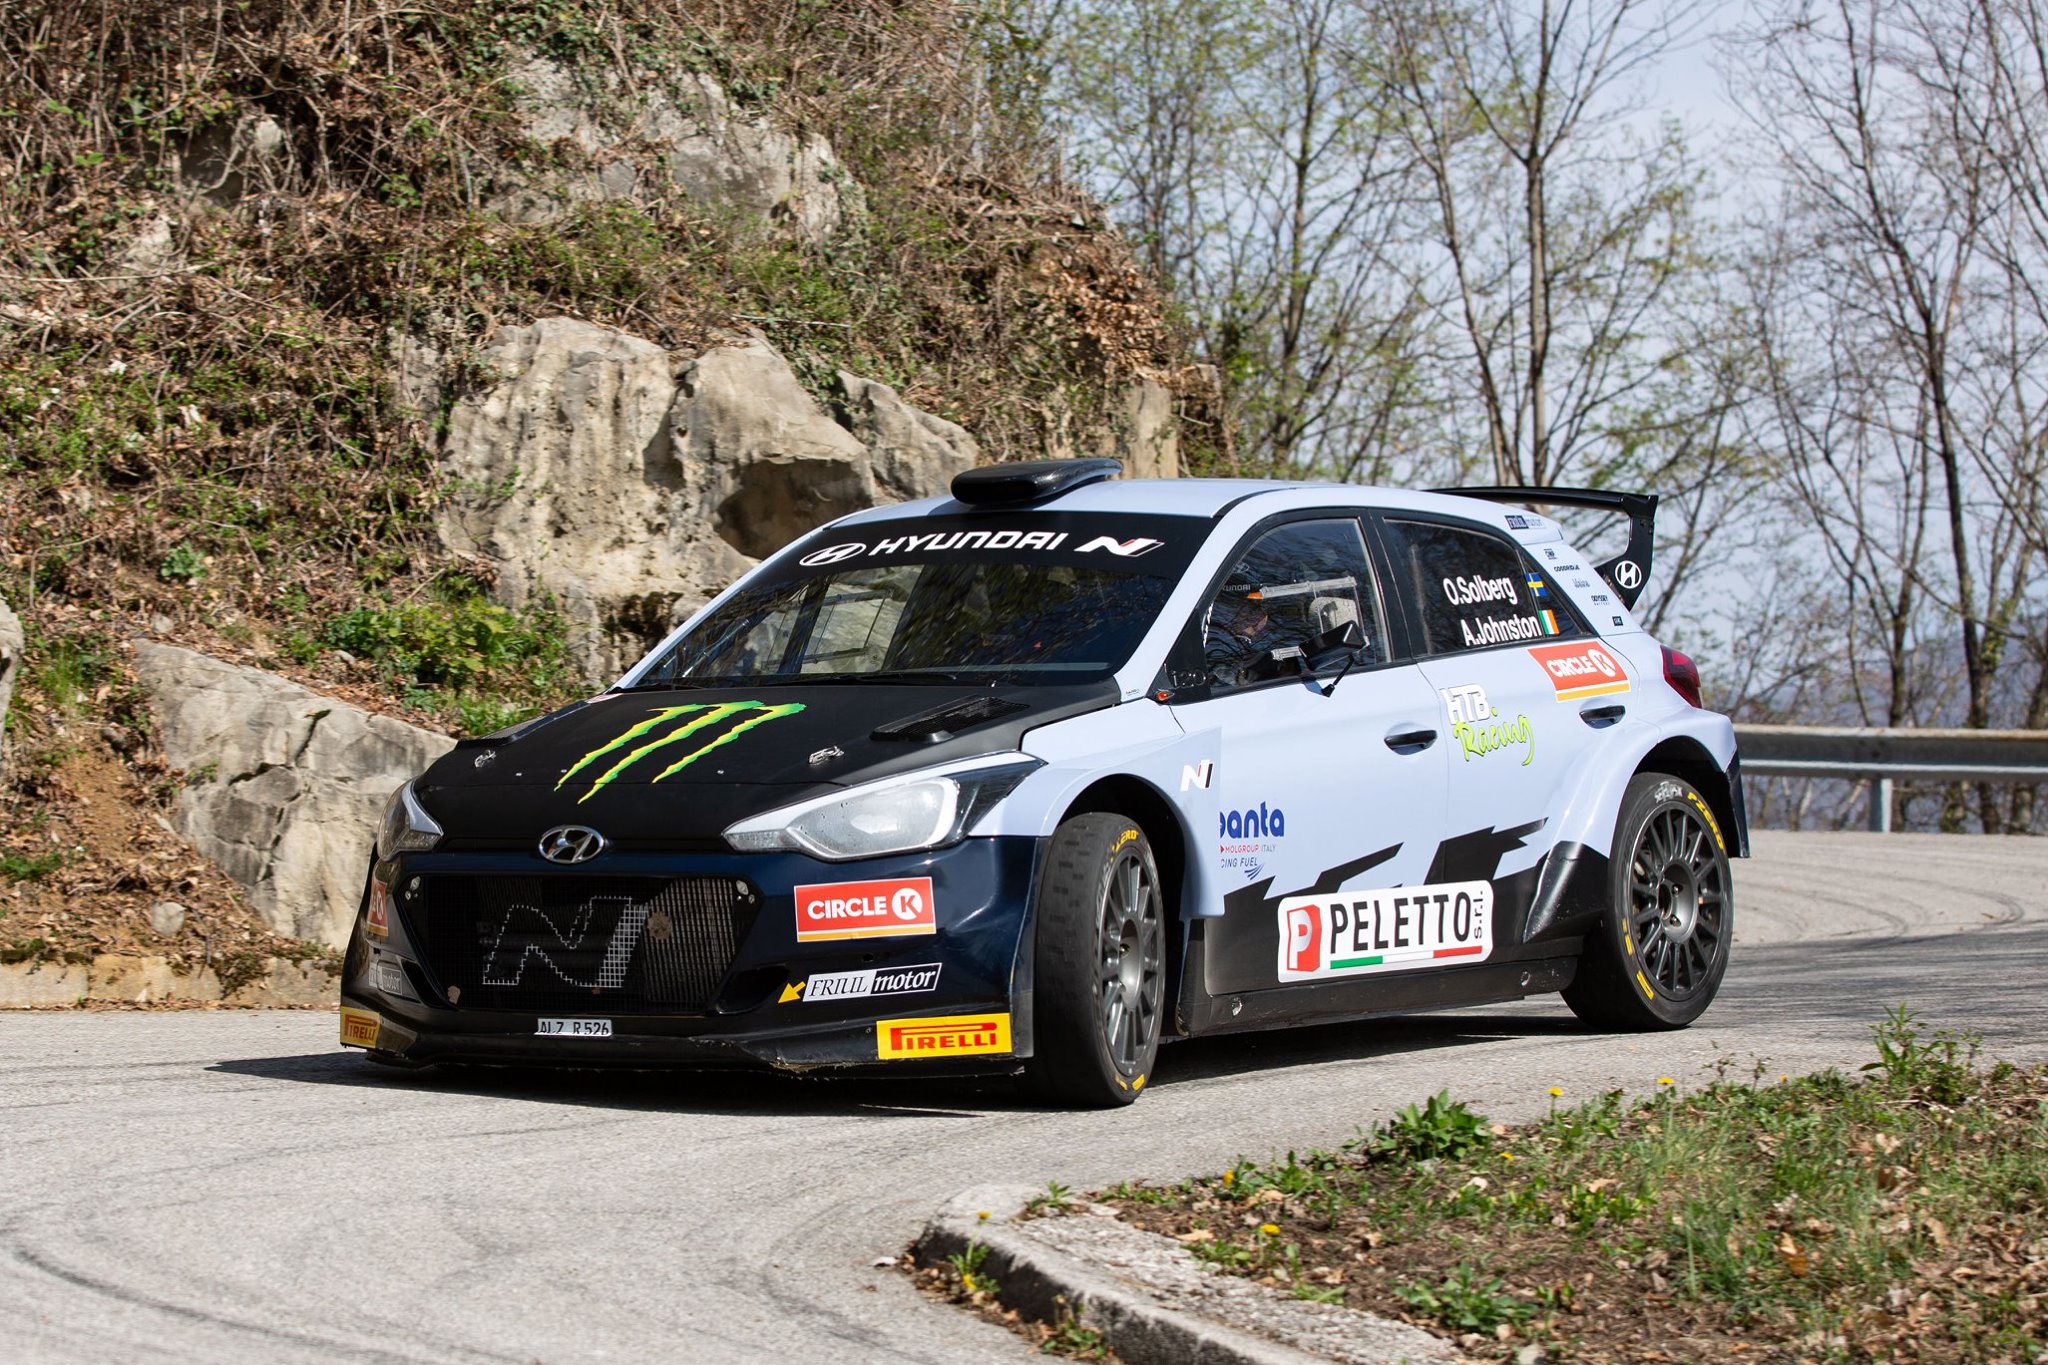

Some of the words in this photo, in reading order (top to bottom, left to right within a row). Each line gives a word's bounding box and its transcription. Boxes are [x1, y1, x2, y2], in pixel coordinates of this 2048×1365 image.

[869, 531, 1068, 555] HYUNDAI
[1443, 575, 1518, 605] O.Solberg
[1461, 614, 1542, 646] A.Johnston
[1546, 656, 1597, 678] CIRCLE
[1439, 683, 1490, 725] HTB
[1453, 707, 1534, 766] Racing
[1225, 844, 1259, 853] MOLGROUP
[1261, 844, 1276, 852] ITALY
[1240, 857, 1258, 867] FUEL
[807, 896, 887, 920] CIRCLE
[894, 889, 922, 919] K
[1330, 891, 1471, 954] PELETTO
[874, 970, 936, 992] motor
[344, 1014, 378, 1041] PIRELLI
[890, 1022, 998, 1051] PIRELLI
